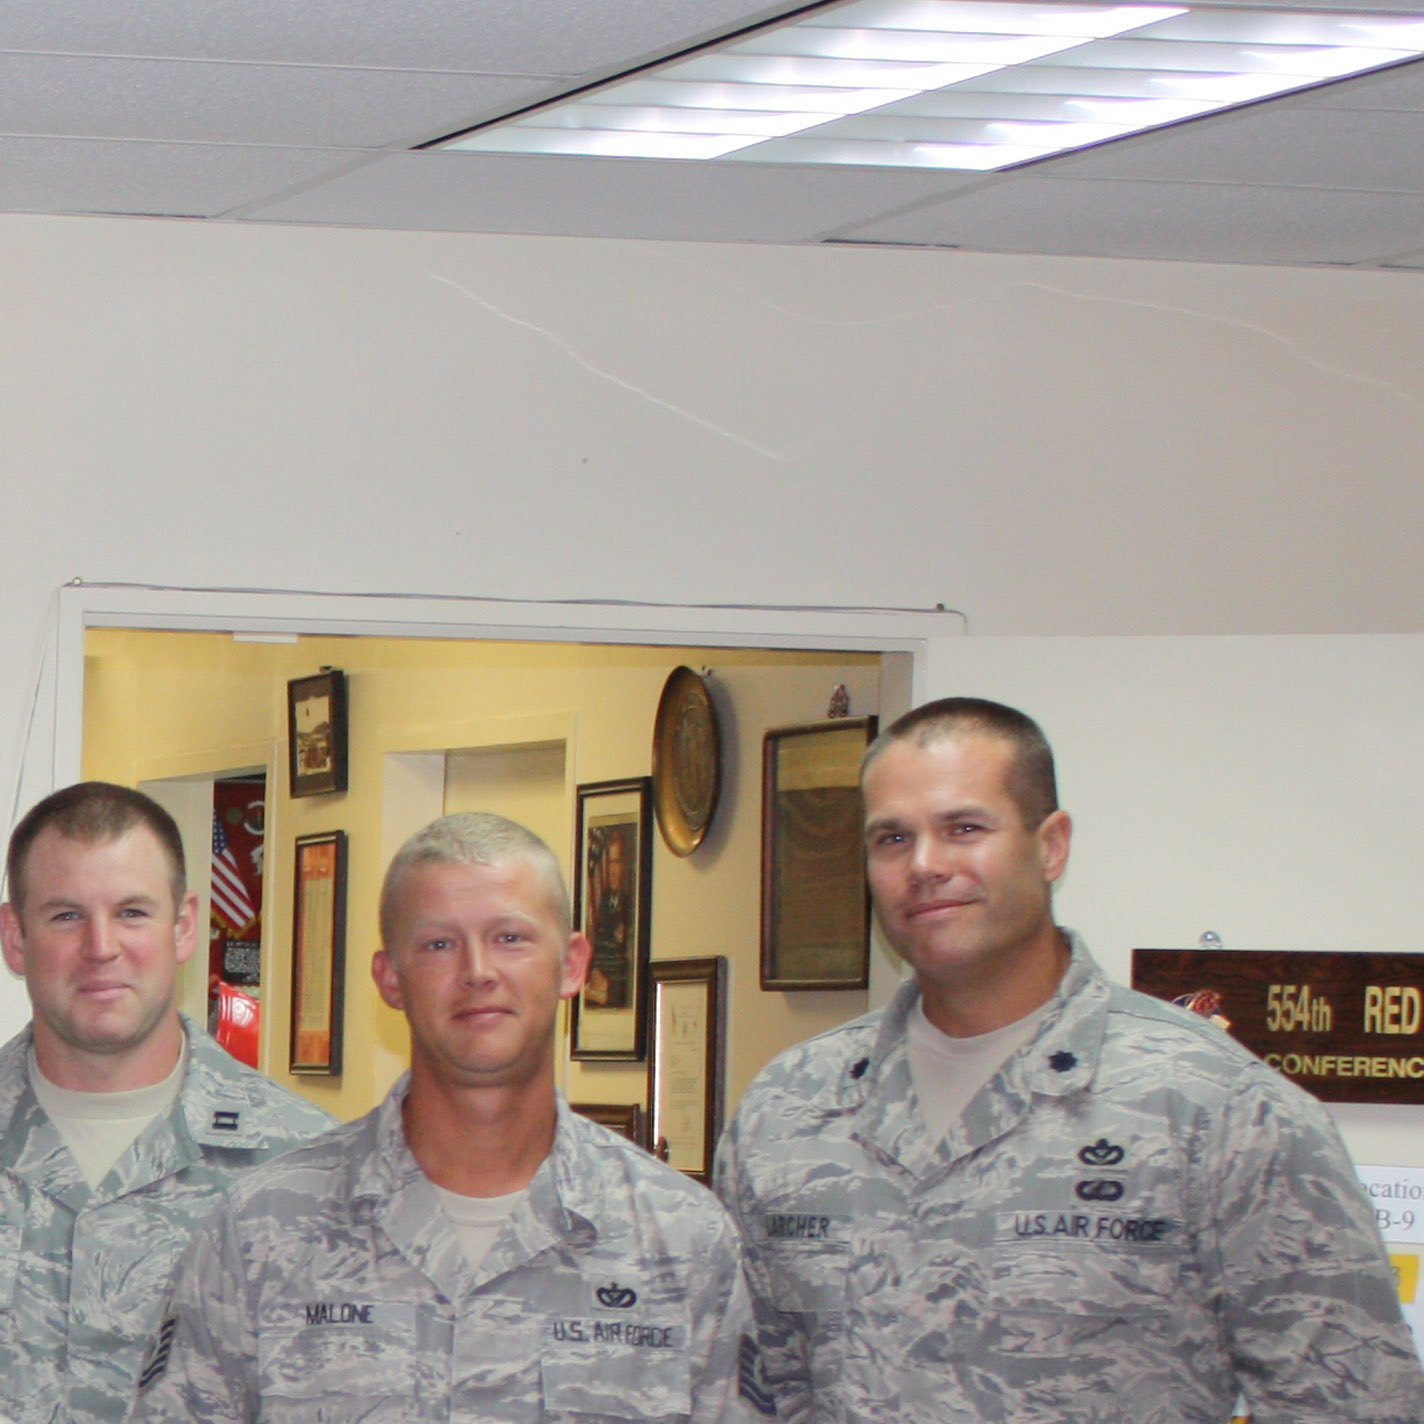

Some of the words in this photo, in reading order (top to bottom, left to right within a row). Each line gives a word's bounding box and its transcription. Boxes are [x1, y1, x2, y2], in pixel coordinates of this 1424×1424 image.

[1267, 985, 1332, 1032] 554th
[1363, 985, 1421, 1035] RED
[1359, 1178, 1424, 1200] catio
[1053, 1215, 1088, 1237] AIR
[1095, 1217, 1167, 1241] FORCE
[306, 1303, 374, 1325] MALONE
[593, 1321, 623, 1342] AIR
[625, 1324, 673, 1347] FORCE
